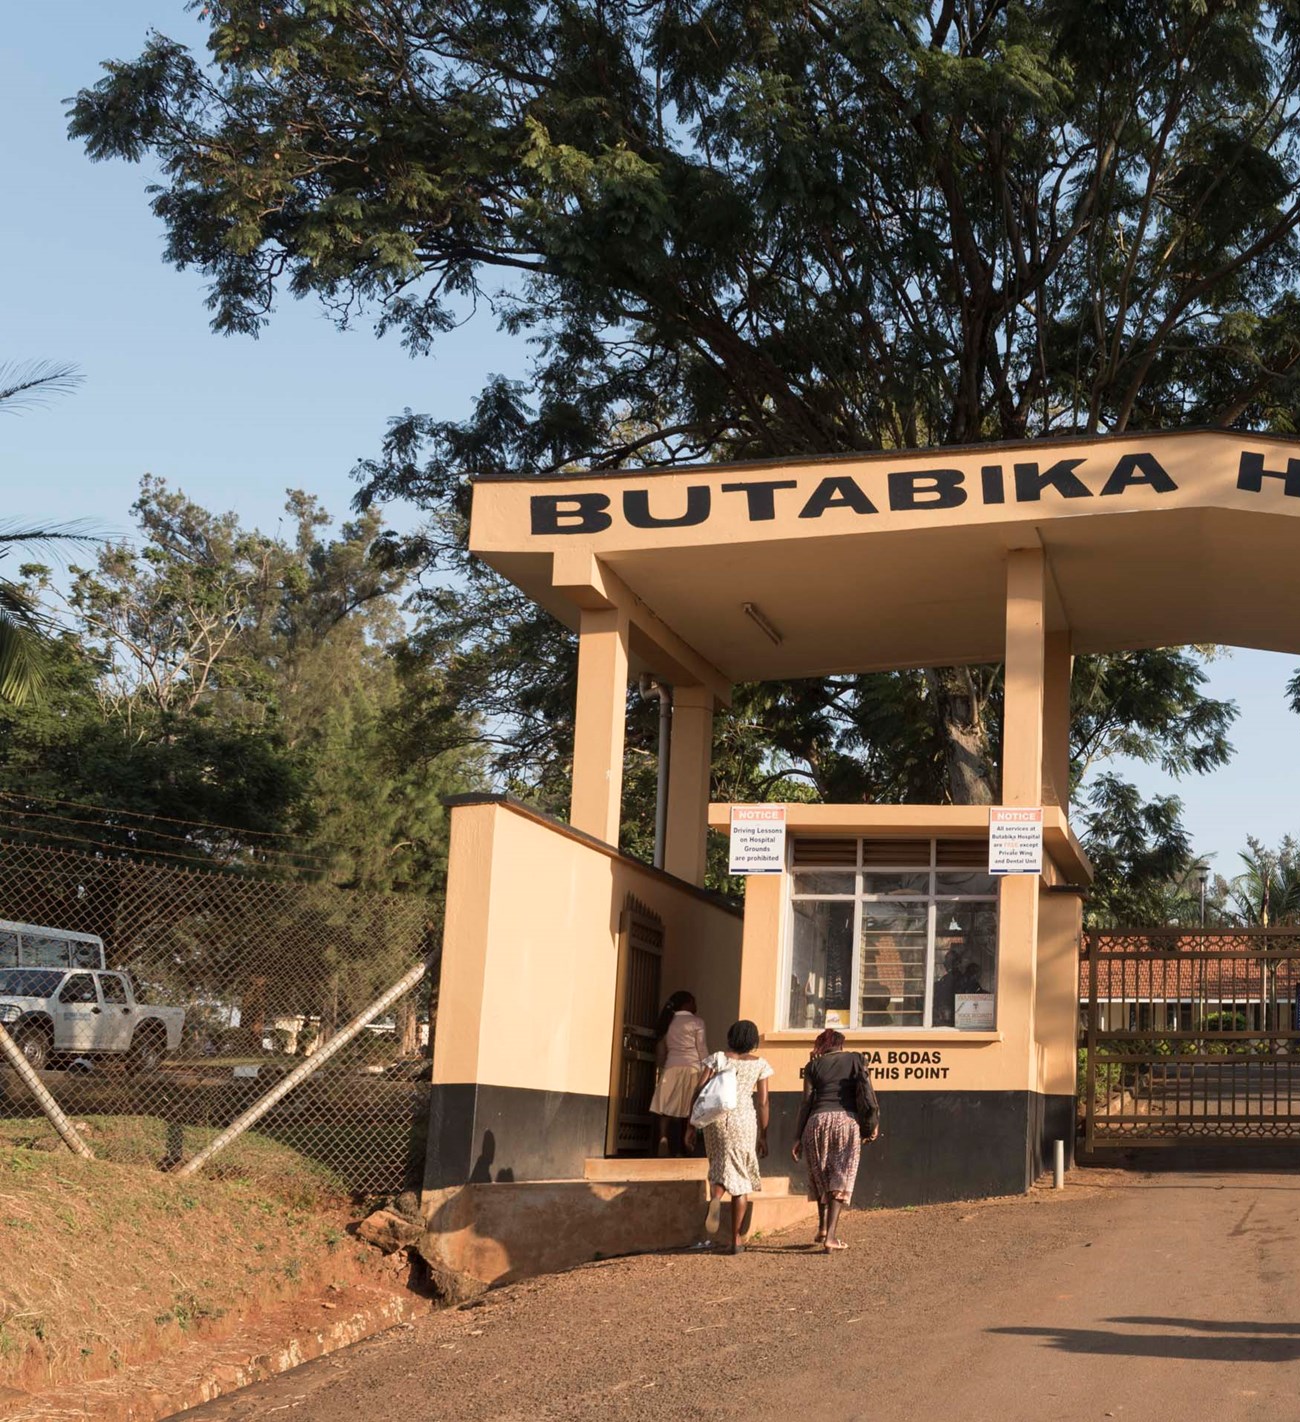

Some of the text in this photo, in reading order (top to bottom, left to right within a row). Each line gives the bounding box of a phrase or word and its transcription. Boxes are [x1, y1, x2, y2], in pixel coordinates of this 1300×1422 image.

[530, 453, 1178, 535] BUTABIKA
[738, 811, 778, 819] NOTICE
[888, 1052, 941, 1064] BODAS
[868, 1068, 949, 1079] THIS POINT
